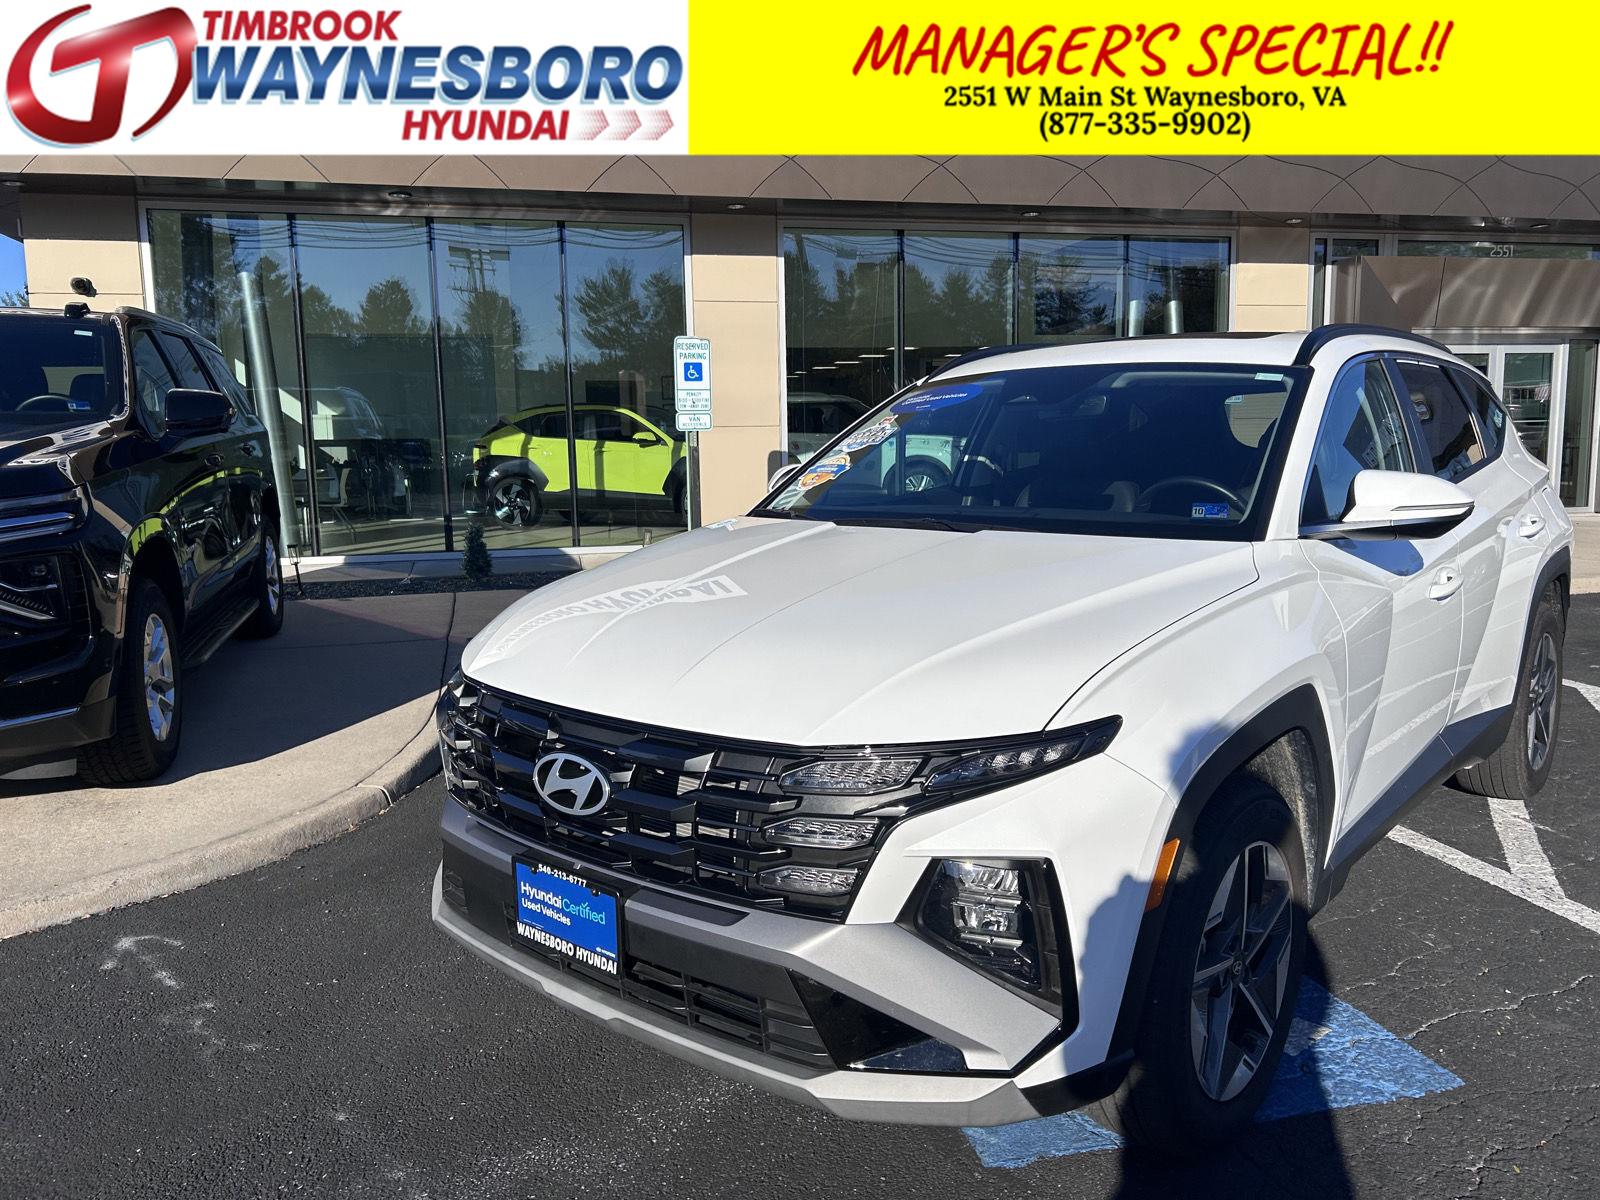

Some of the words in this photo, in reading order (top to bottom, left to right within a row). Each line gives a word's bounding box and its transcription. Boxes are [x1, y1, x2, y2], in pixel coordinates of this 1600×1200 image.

[1490, 244, 1514, 257] 2551
[676, 342, 709, 351] RESERVED
[679, 352, 707, 360] PARKING
[538, 863, 587, 888] 540-213-6777
[520, 881, 562, 909] Hyundai
[562, 898, 606, 925] Certified
[521, 897, 541, 913] Used
[541, 904, 571, 926] Vehicles
[516, 920, 574, 956] WAYNESBORO
[575, 946, 618, 975] HYUNDAI
